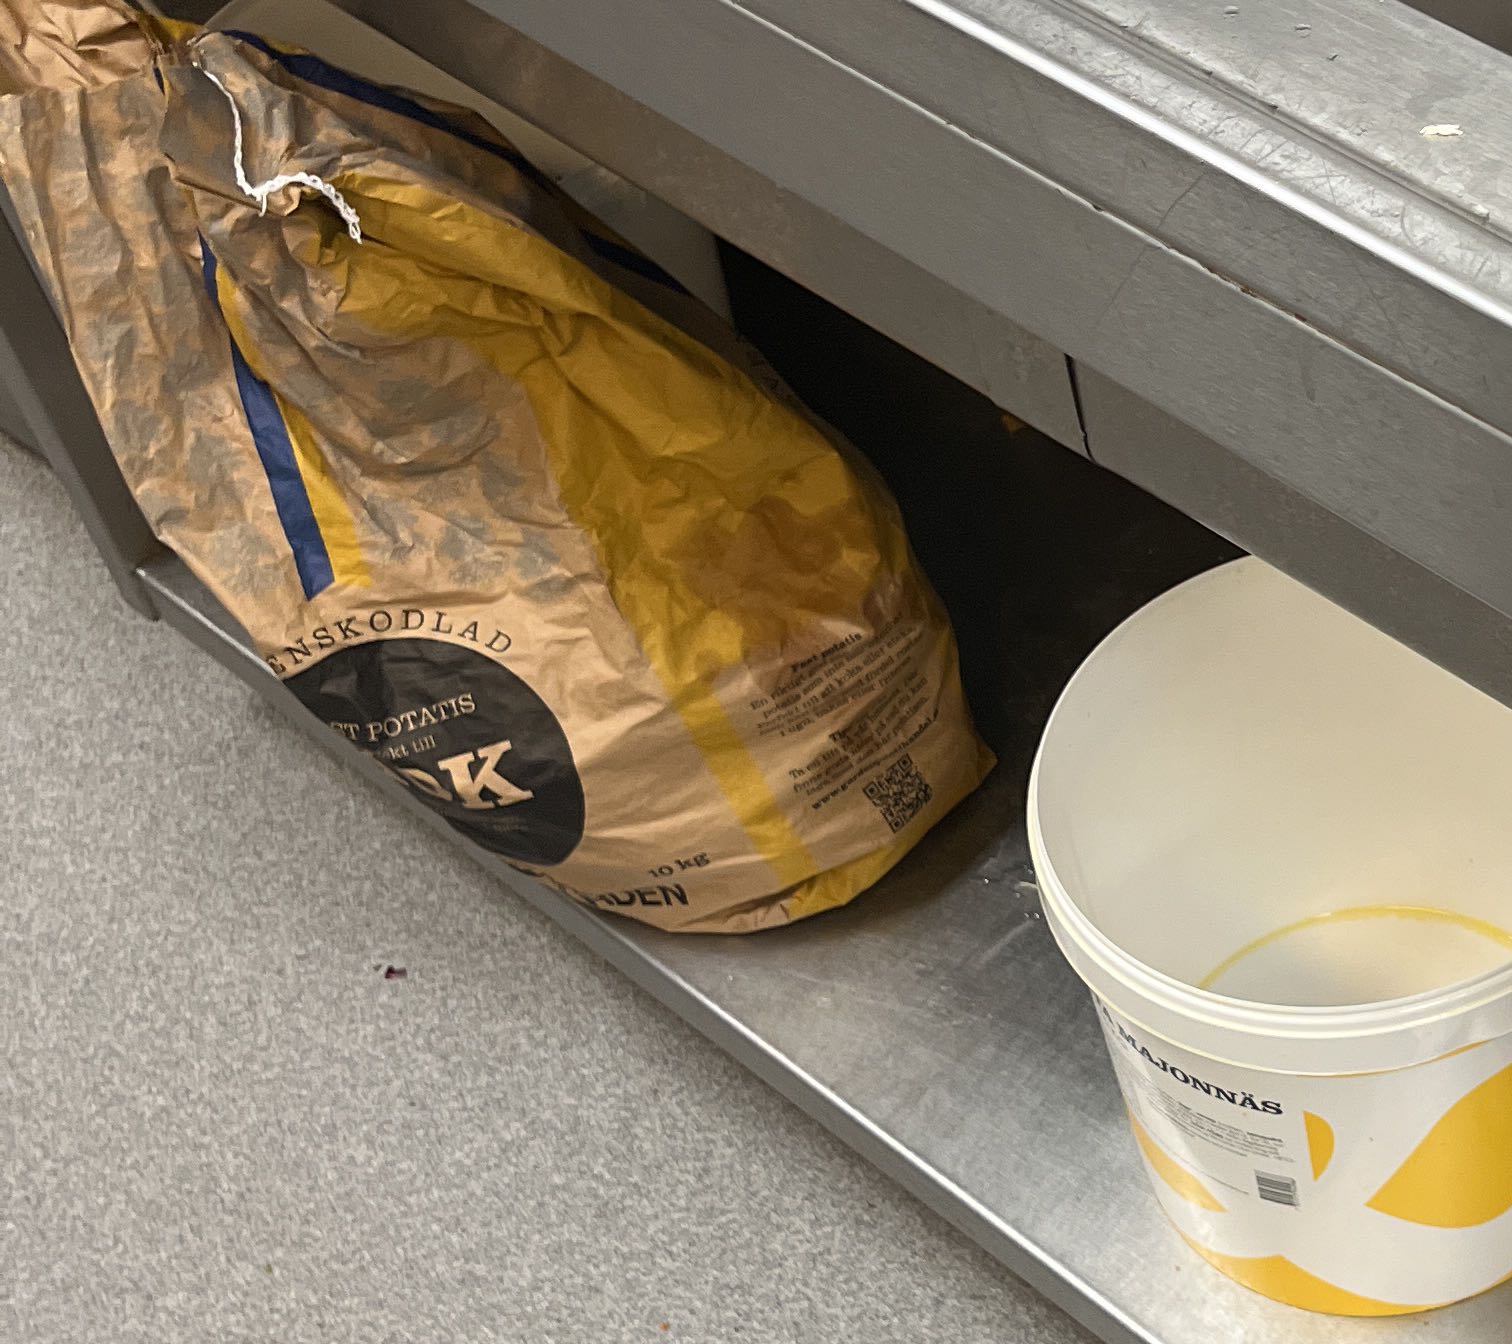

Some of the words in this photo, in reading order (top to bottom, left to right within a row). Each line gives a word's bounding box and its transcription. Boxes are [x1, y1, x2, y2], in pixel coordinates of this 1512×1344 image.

[366, 692, 476, 742] POTATIS
[648, 864, 674, 878] 10
[1117, 1021, 1284, 1116] MAJONNÄS
